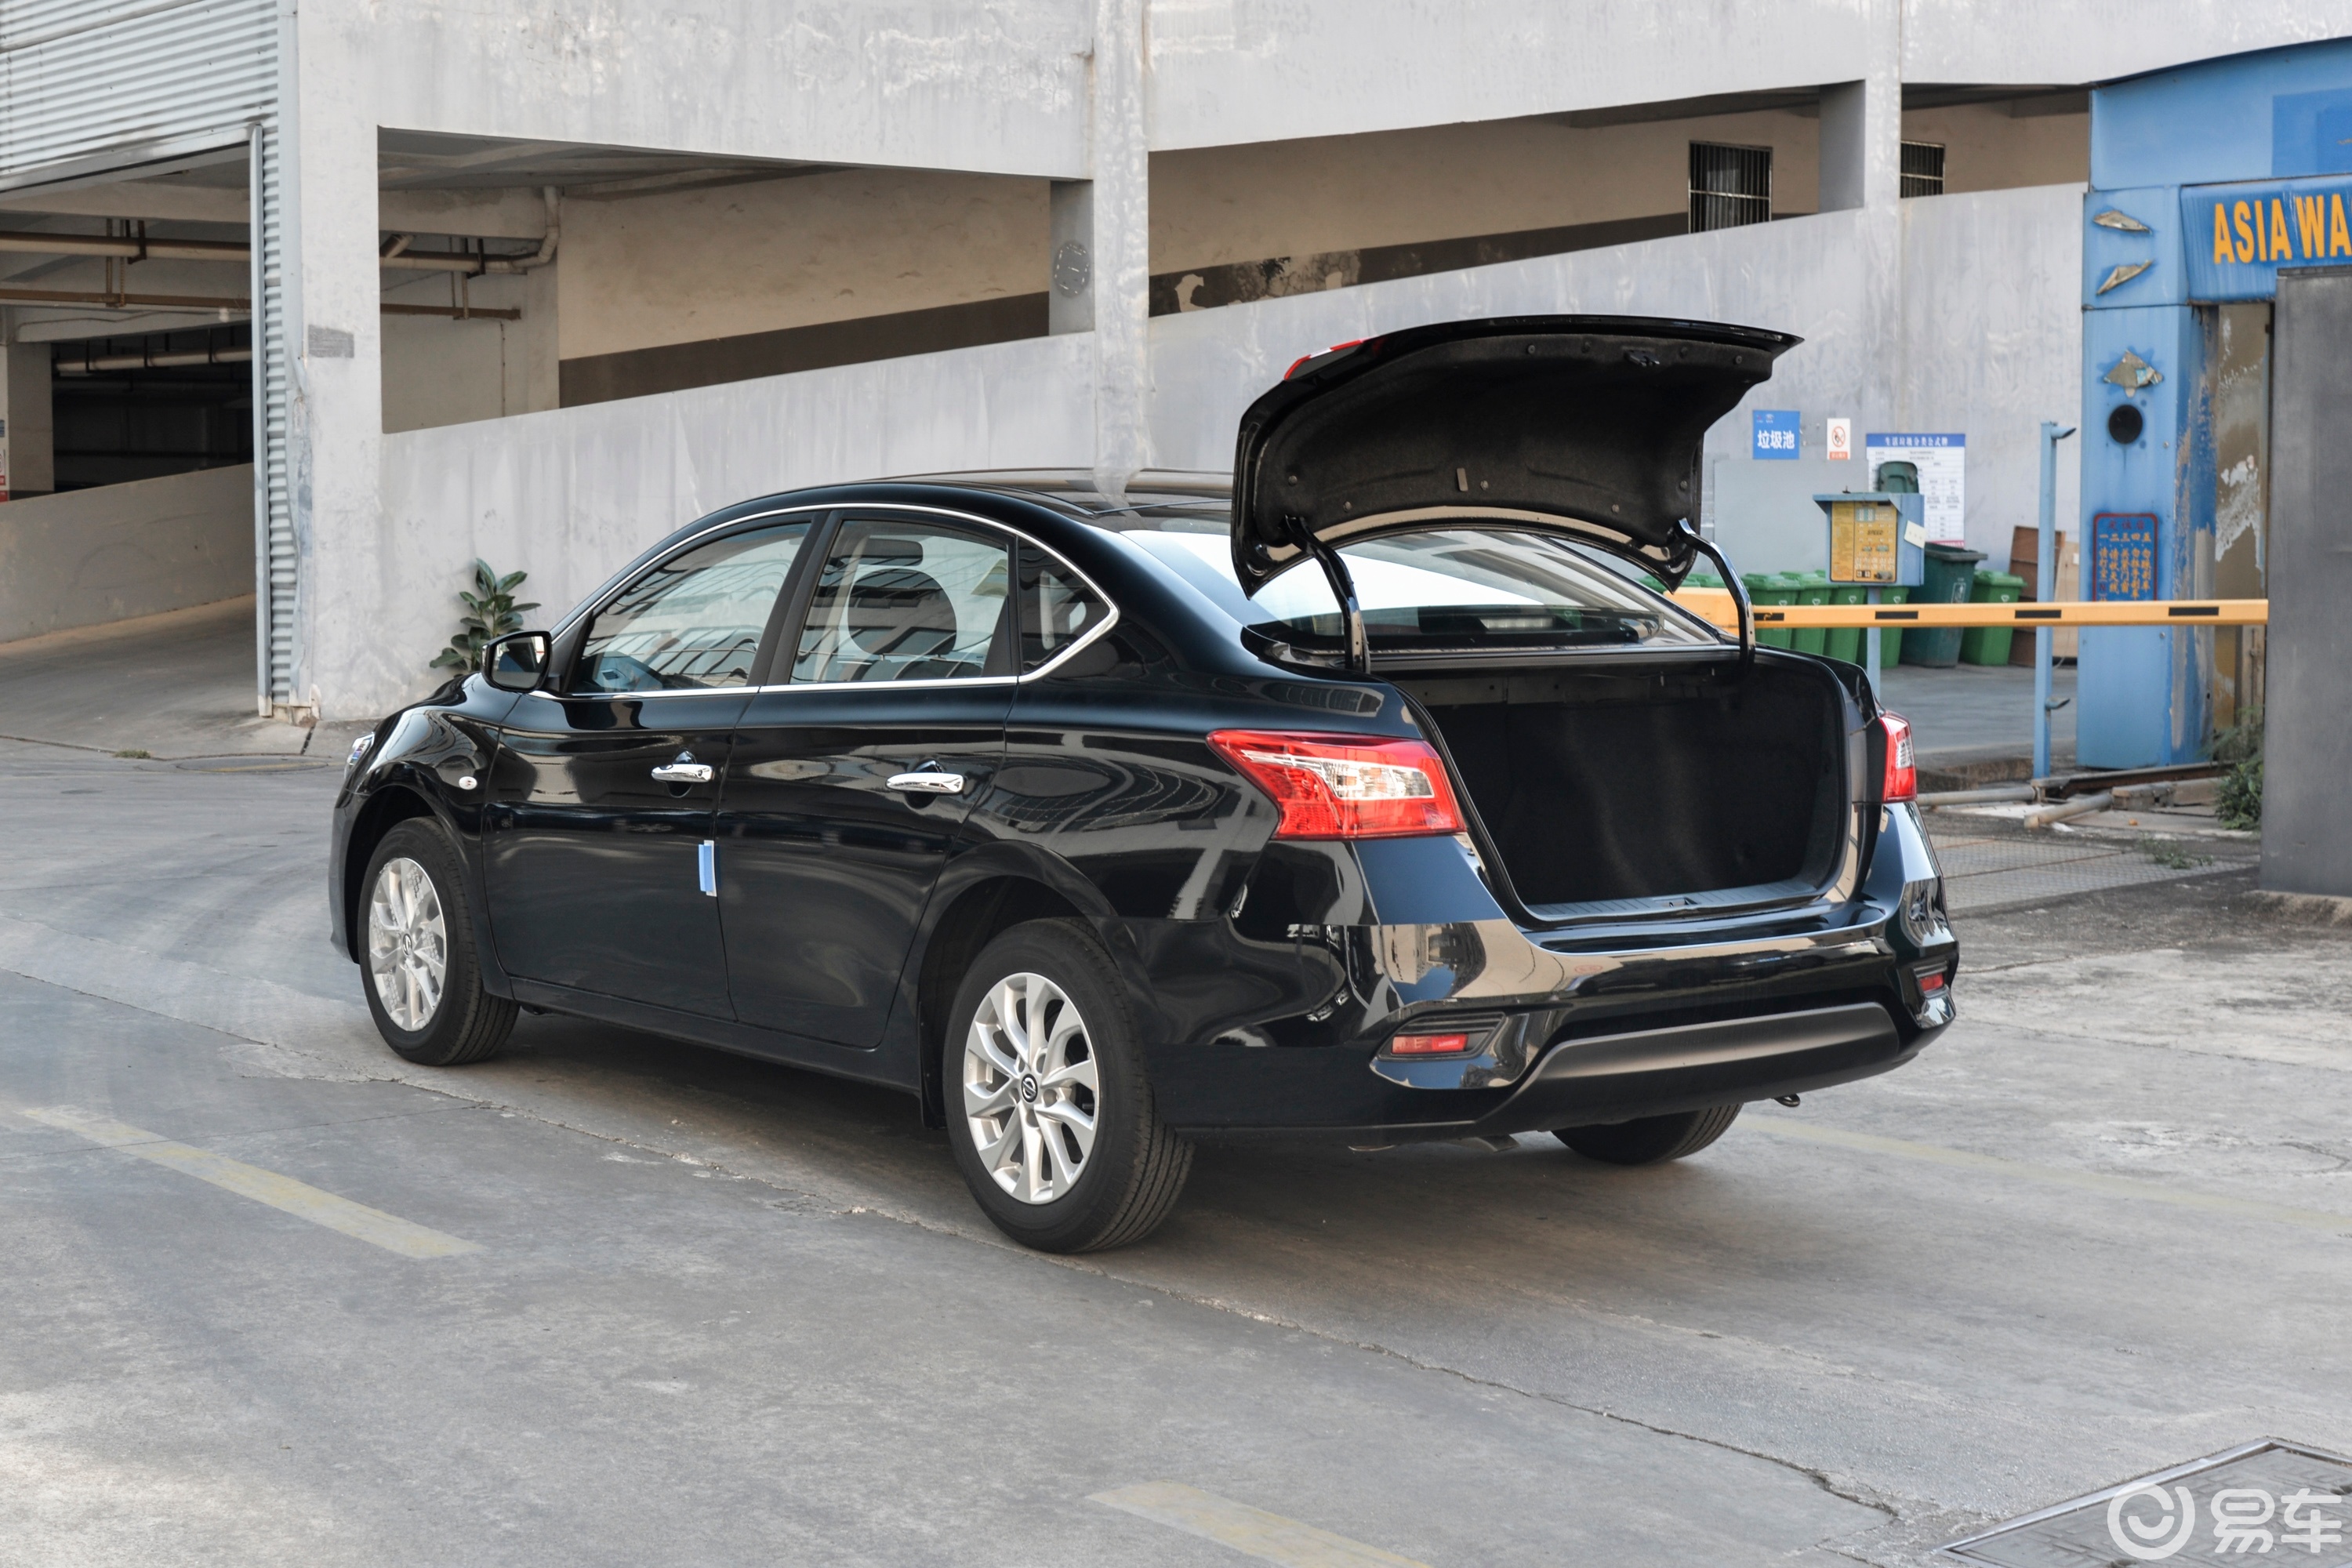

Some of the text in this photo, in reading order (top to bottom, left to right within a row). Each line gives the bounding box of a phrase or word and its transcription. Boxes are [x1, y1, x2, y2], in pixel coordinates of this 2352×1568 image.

[2213, 194, 2352, 264] ASIA WA
[1757, 429, 1795, 449] 垃圾池
